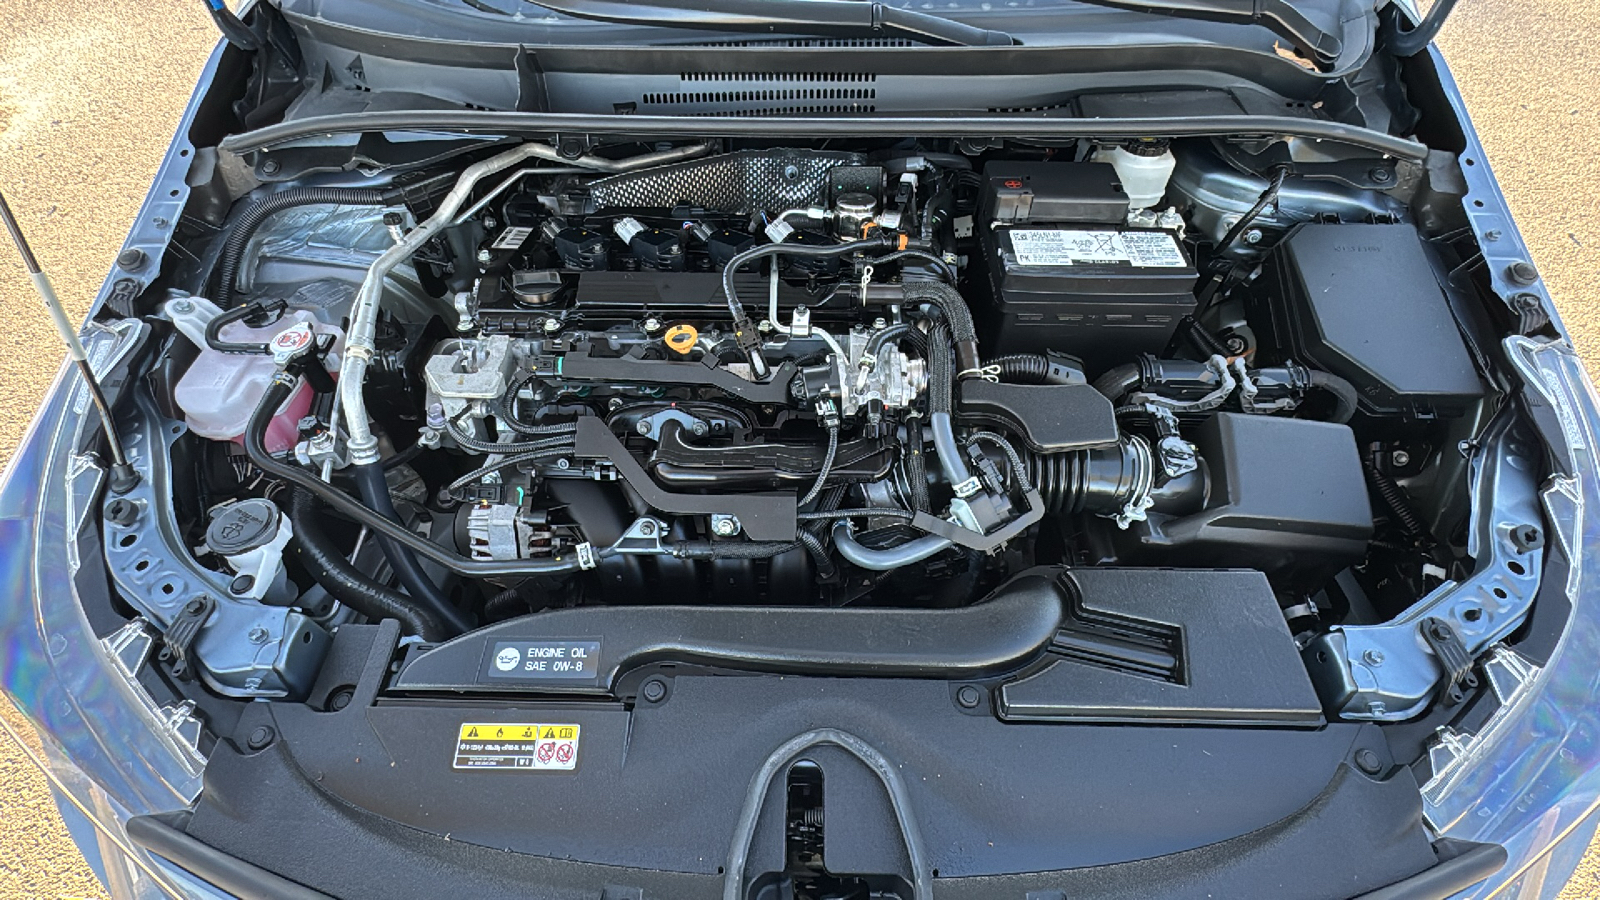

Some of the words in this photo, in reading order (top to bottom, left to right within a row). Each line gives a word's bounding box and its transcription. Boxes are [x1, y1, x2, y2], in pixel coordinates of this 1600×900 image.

[527, 647, 565, 658] ENGINE
[571, 647, 588, 658] OIL
[525, 661, 547, 671] SAE
